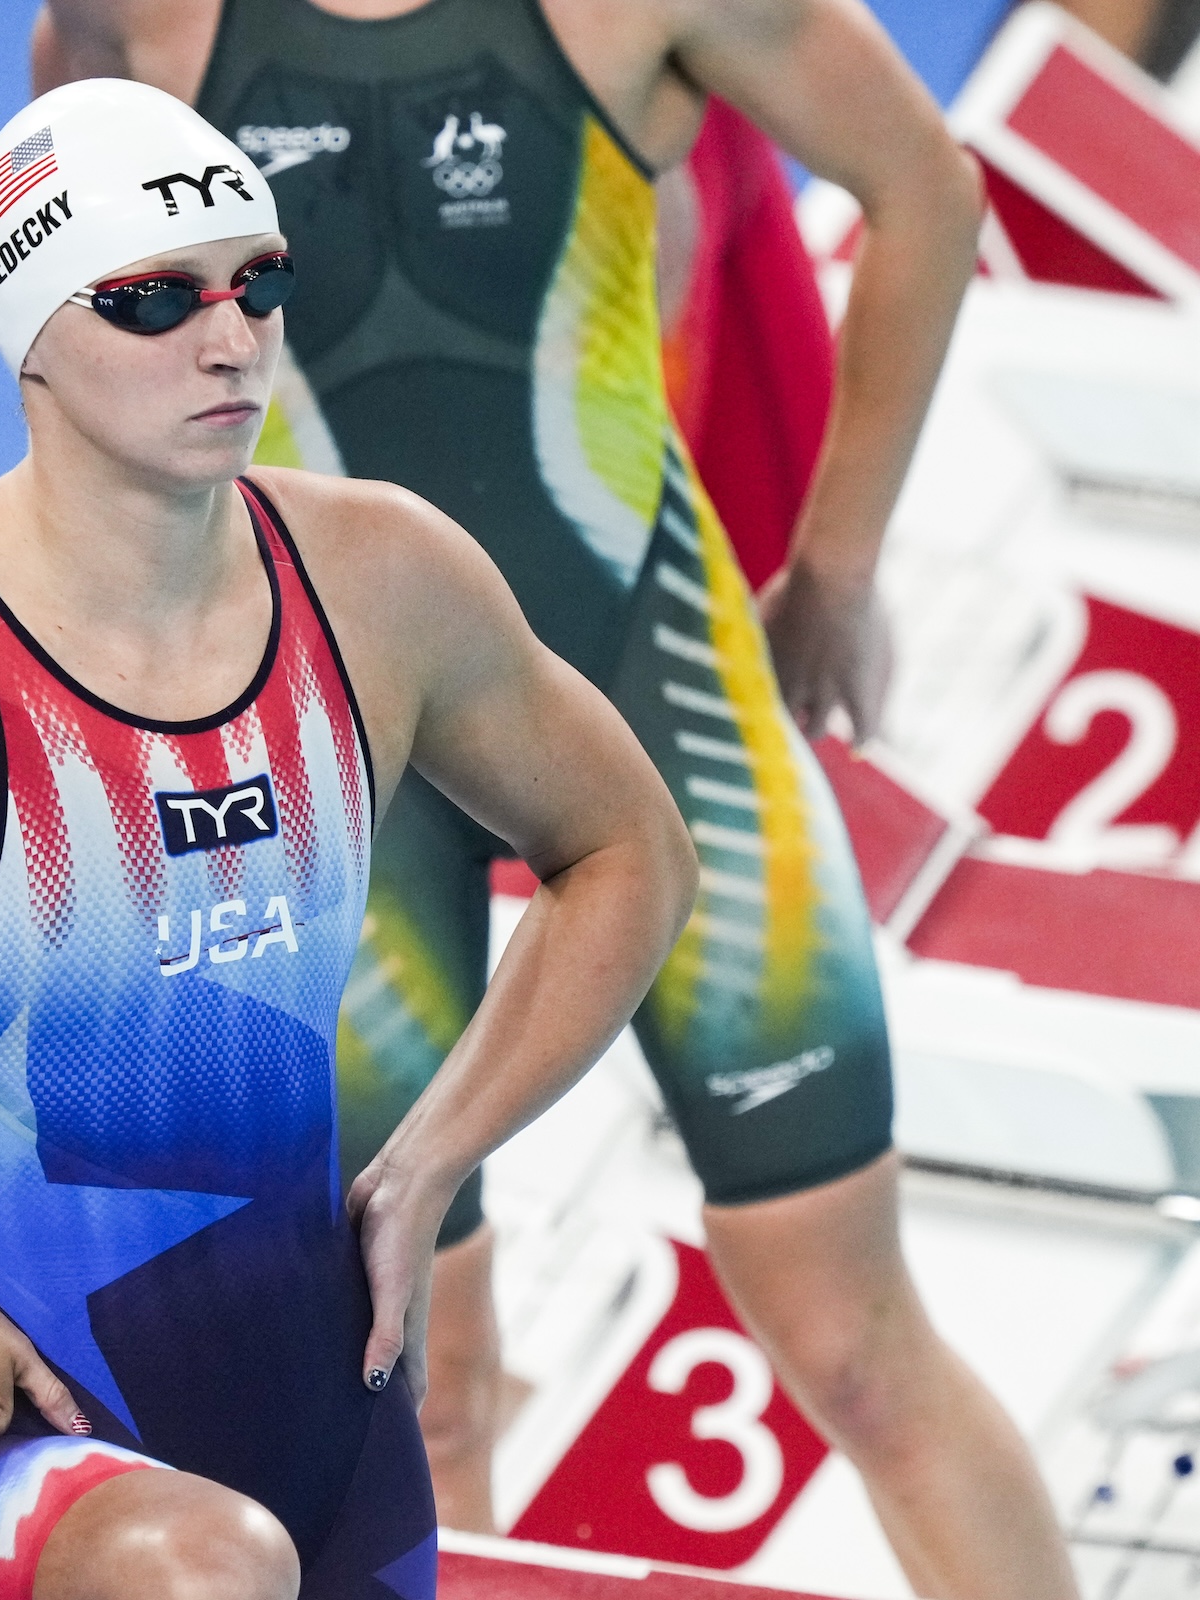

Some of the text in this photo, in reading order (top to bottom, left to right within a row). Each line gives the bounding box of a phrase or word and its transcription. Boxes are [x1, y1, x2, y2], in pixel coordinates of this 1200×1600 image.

[141, 165, 255, 216] TYR
[98, 298, 114, 307] TYR
[1044, 669, 1181, 866] 2
[166, 787, 271, 844] TYR
[157, 895, 300, 977] USA
[646, 1327, 785, 1533] 3
